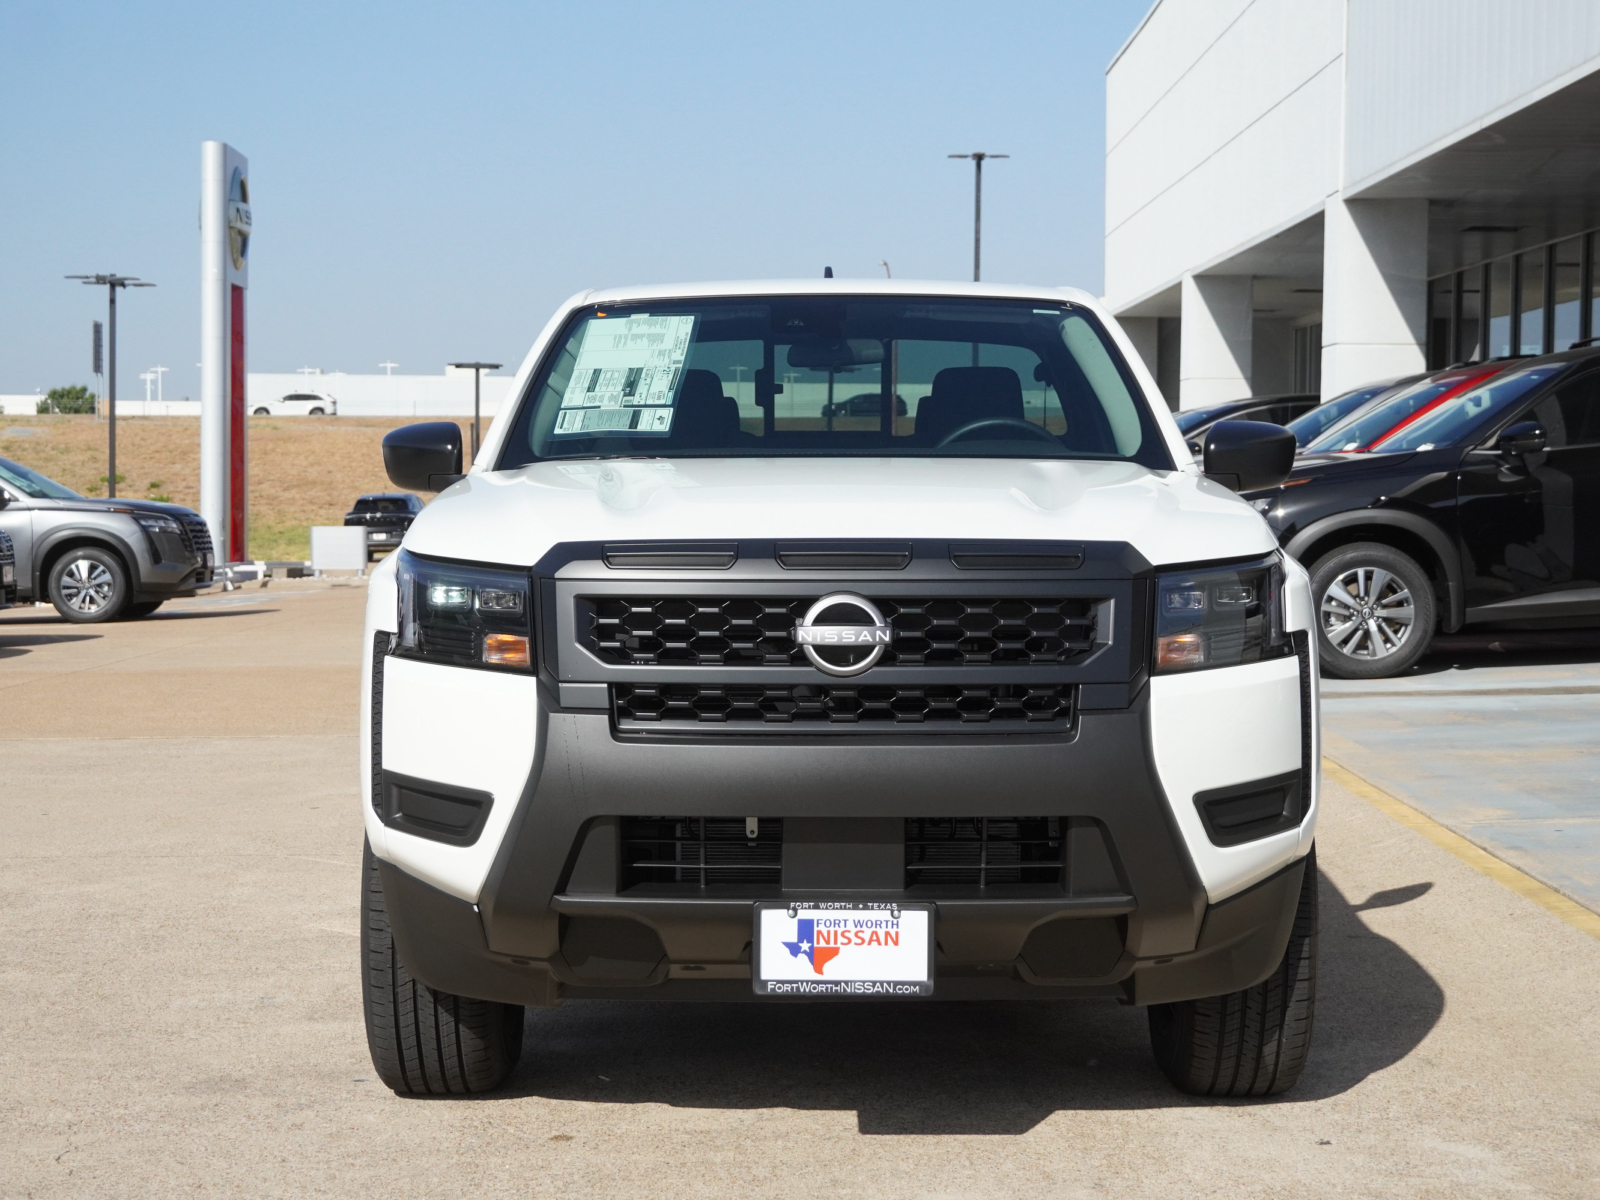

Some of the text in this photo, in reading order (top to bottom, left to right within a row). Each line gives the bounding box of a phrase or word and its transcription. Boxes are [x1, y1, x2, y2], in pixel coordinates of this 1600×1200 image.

[798, 630, 890, 642] NISSAN
[816, 918, 899, 929] FORT WORTH
[816, 930, 899, 946] NISSAN
